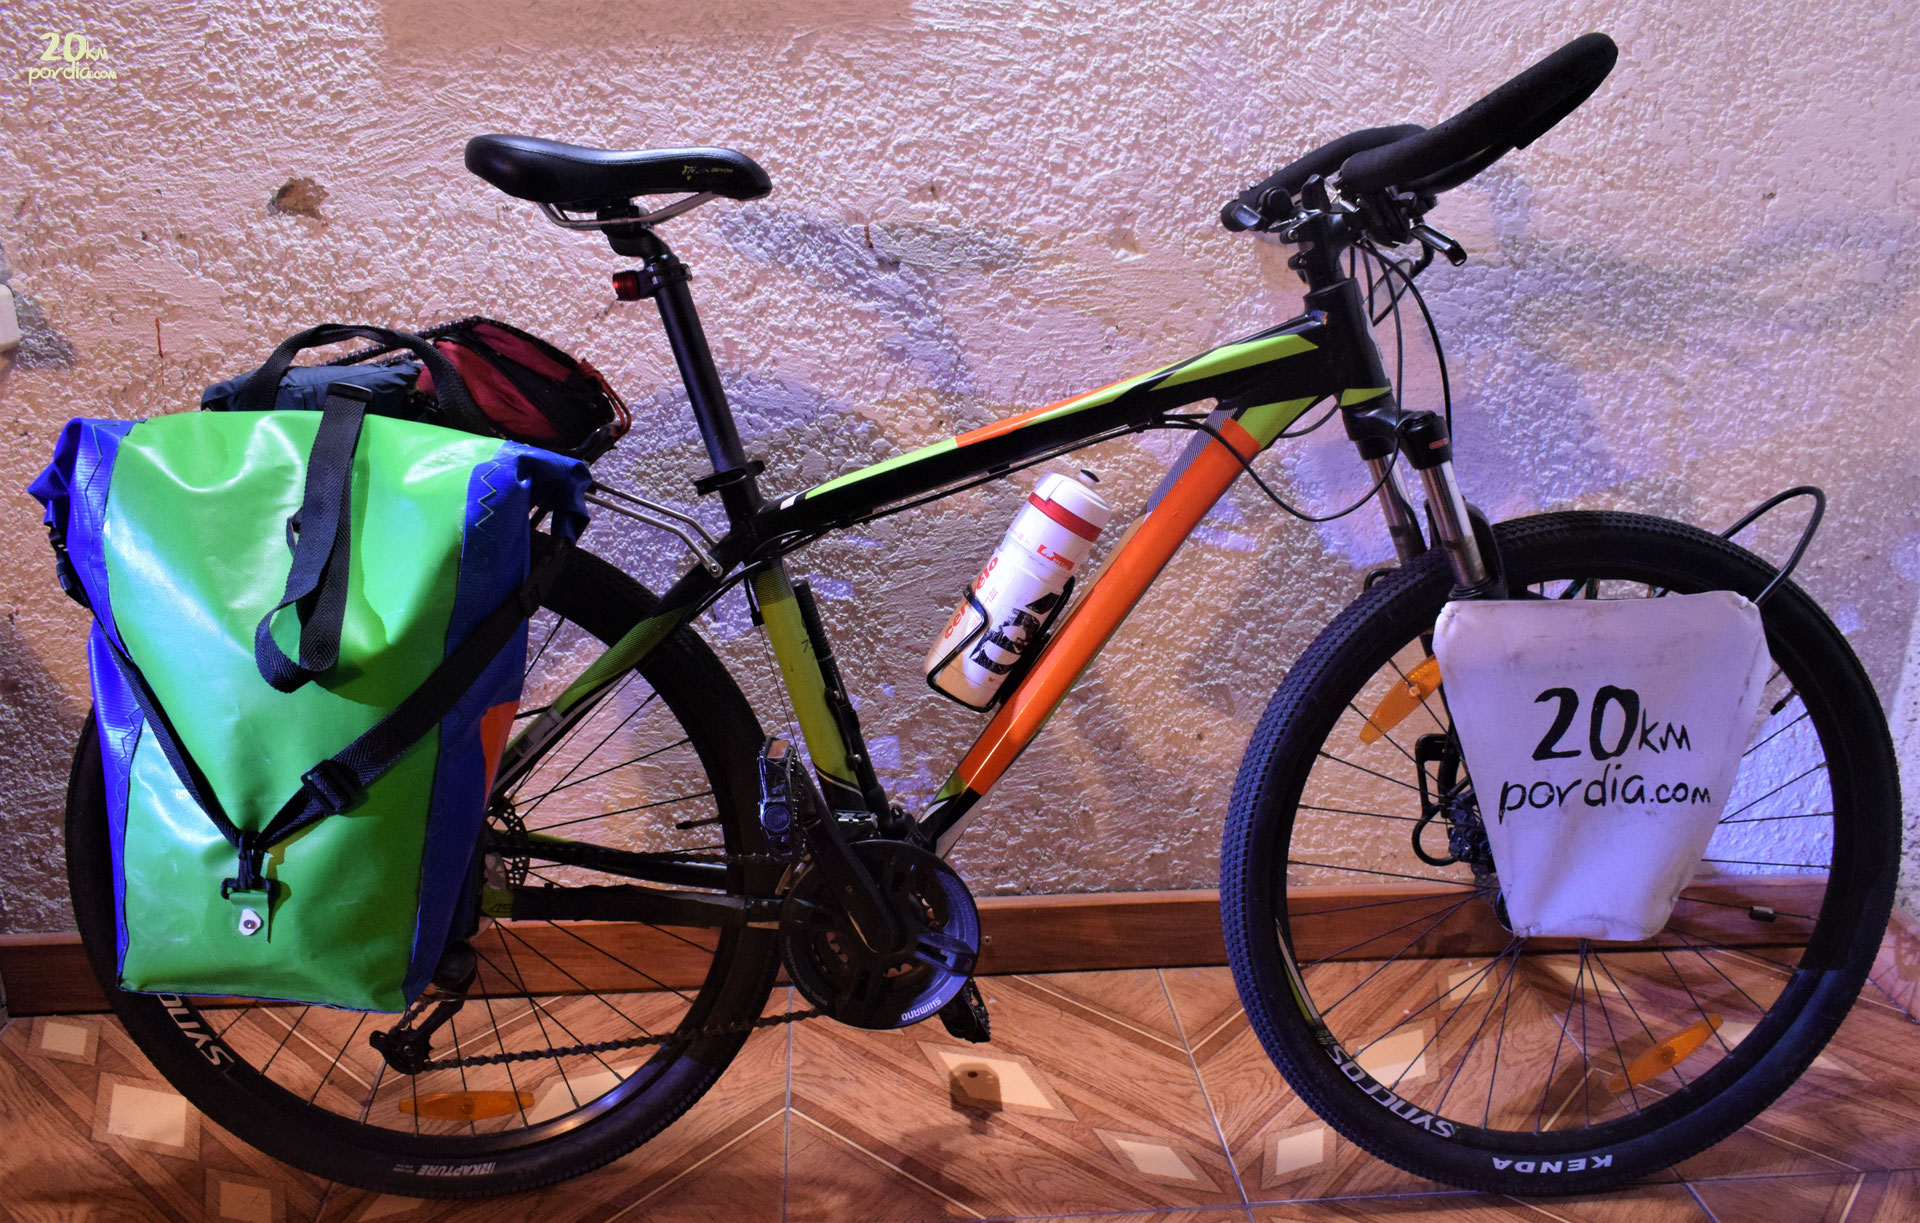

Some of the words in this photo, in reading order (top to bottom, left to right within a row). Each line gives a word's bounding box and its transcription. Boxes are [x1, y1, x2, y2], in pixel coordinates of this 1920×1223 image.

[1498, 763, 1712, 825] pordia.com
[901, 996, 942, 1022] SHIMANO
[416, 1163, 482, 1177] KAPTURE
[1492, 1154, 1613, 1174] KENDA
